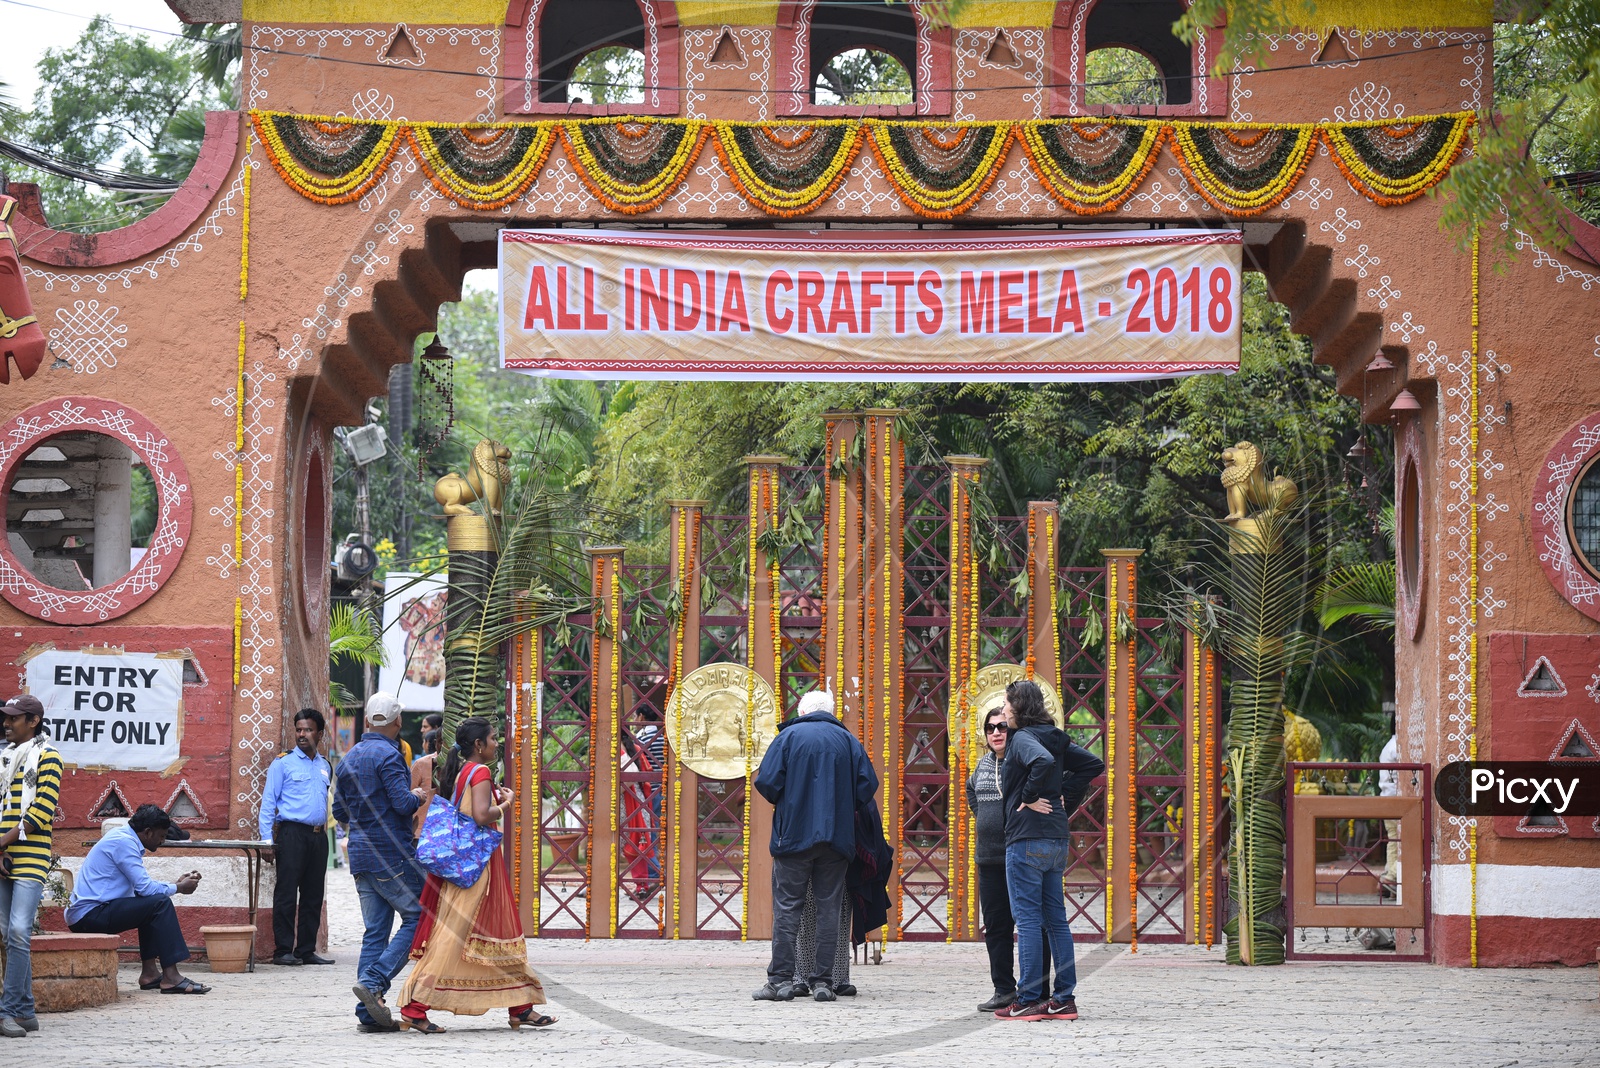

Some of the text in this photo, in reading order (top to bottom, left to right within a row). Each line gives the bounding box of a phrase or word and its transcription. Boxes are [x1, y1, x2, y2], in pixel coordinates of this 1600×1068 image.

[524, 266, 1232, 334] ALL INDIA CRAFTS MELA - 2018
[54, 665, 159, 688] ENTRY
[74, 691, 136, 713] FOR
[42, 718, 171, 745] STAFF ONLY
